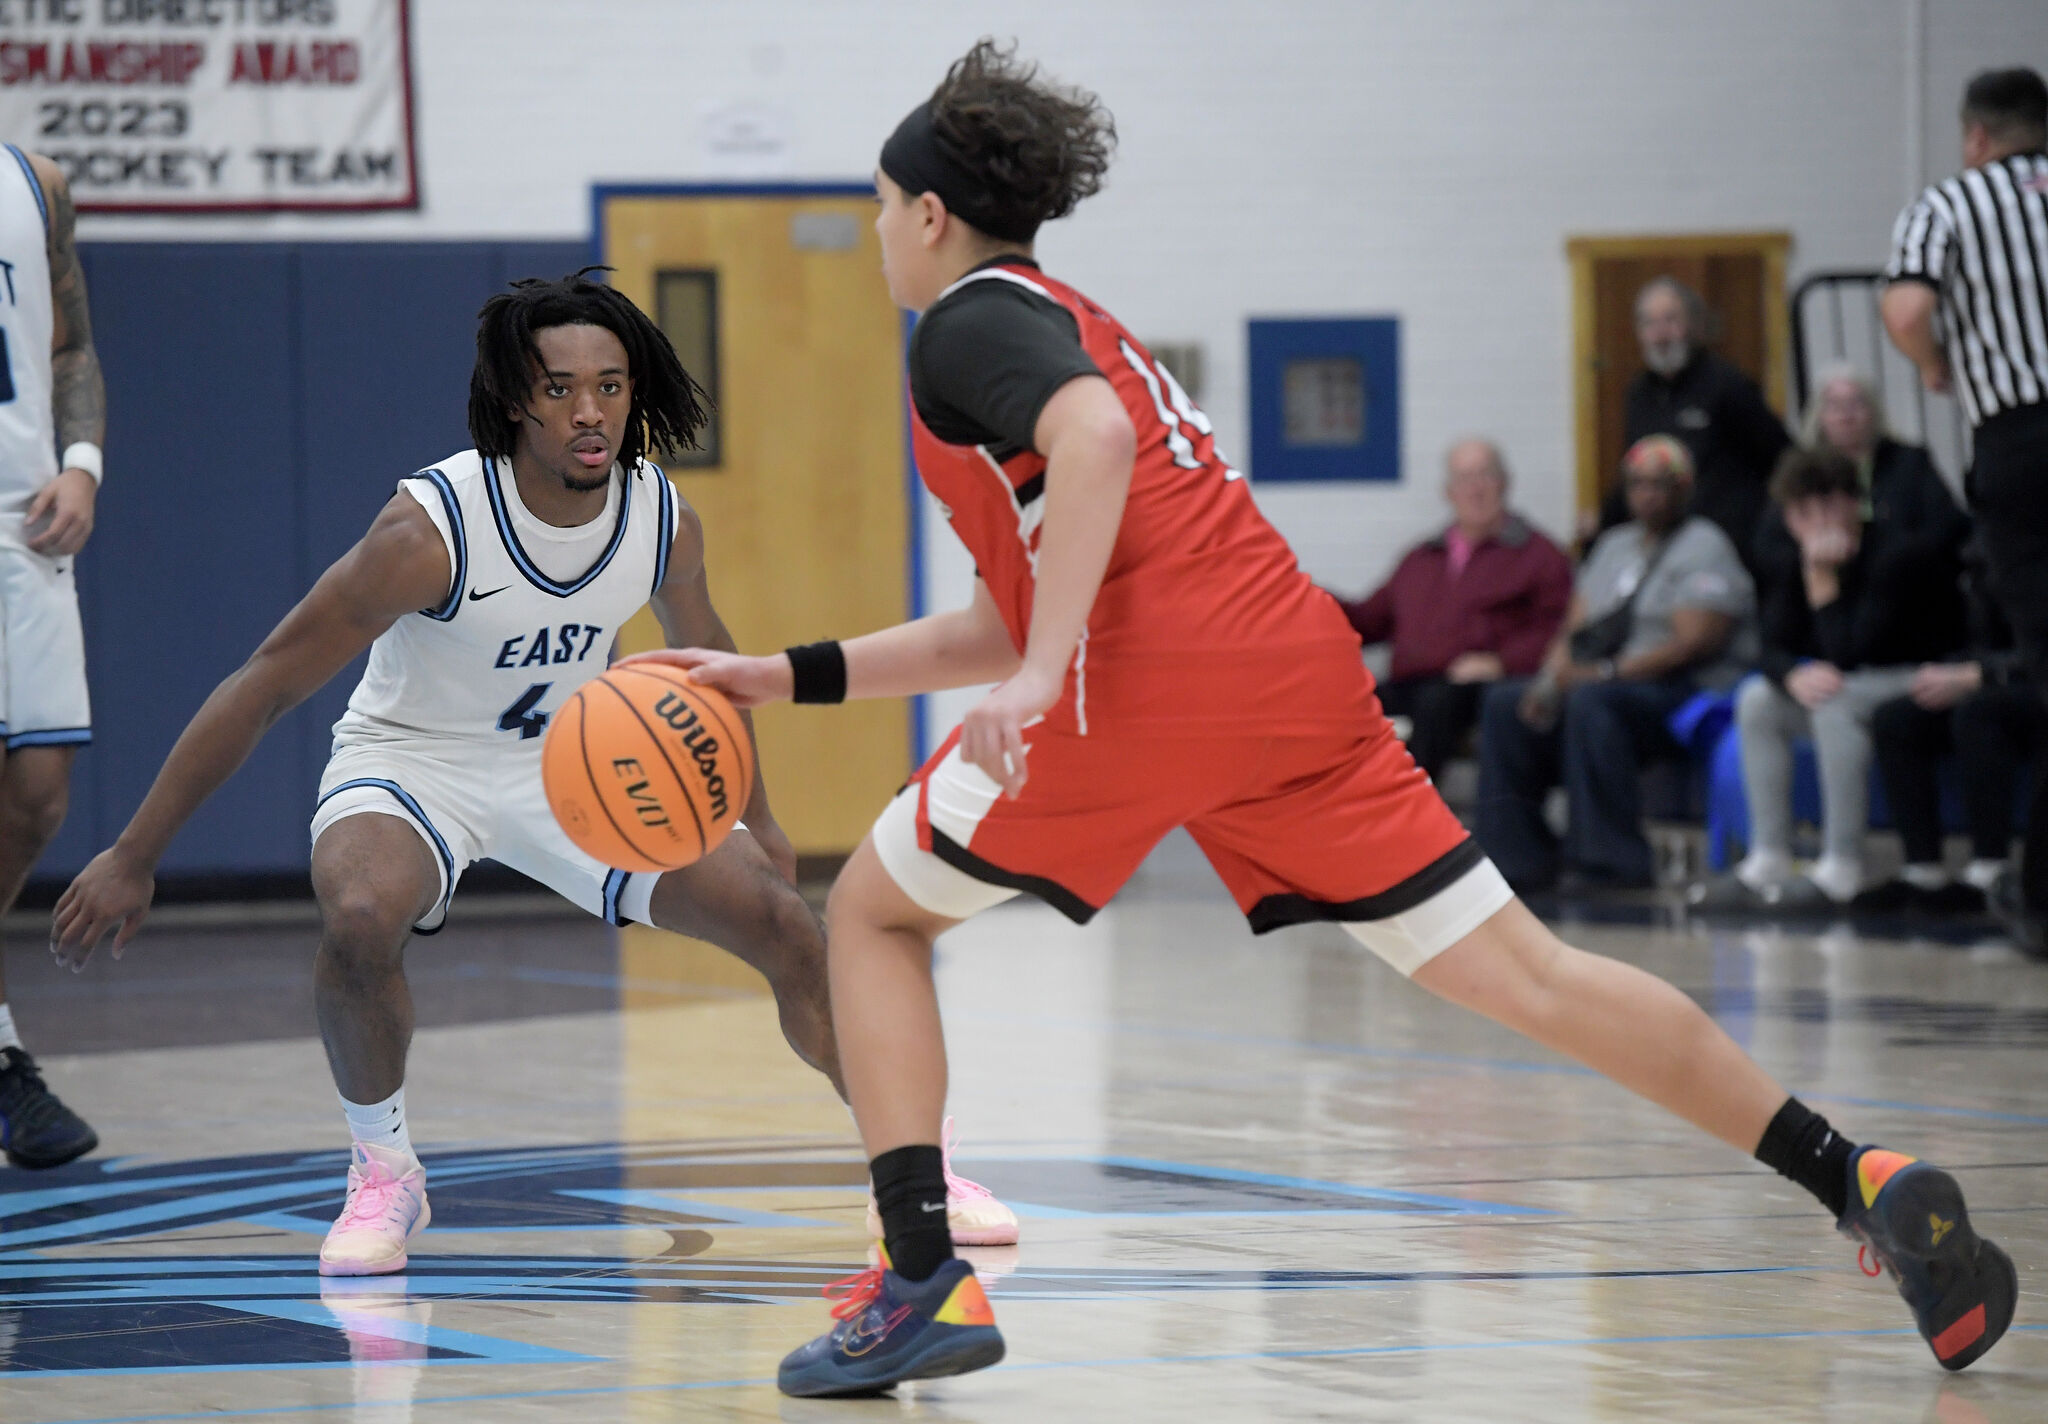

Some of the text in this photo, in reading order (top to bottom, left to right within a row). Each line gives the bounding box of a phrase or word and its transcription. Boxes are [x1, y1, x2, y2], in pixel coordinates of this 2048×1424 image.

[228, 38, 359, 86] AWARD
[40, 102, 188, 136] 2023
[46, 149, 395, 186] OCKEY TEAM
[493, 622, 603, 669] EAST
[494, 681, 552, 741] 4
[654, 690, 729, 823] Wilson
[612, 757, 670, 827] EVO
